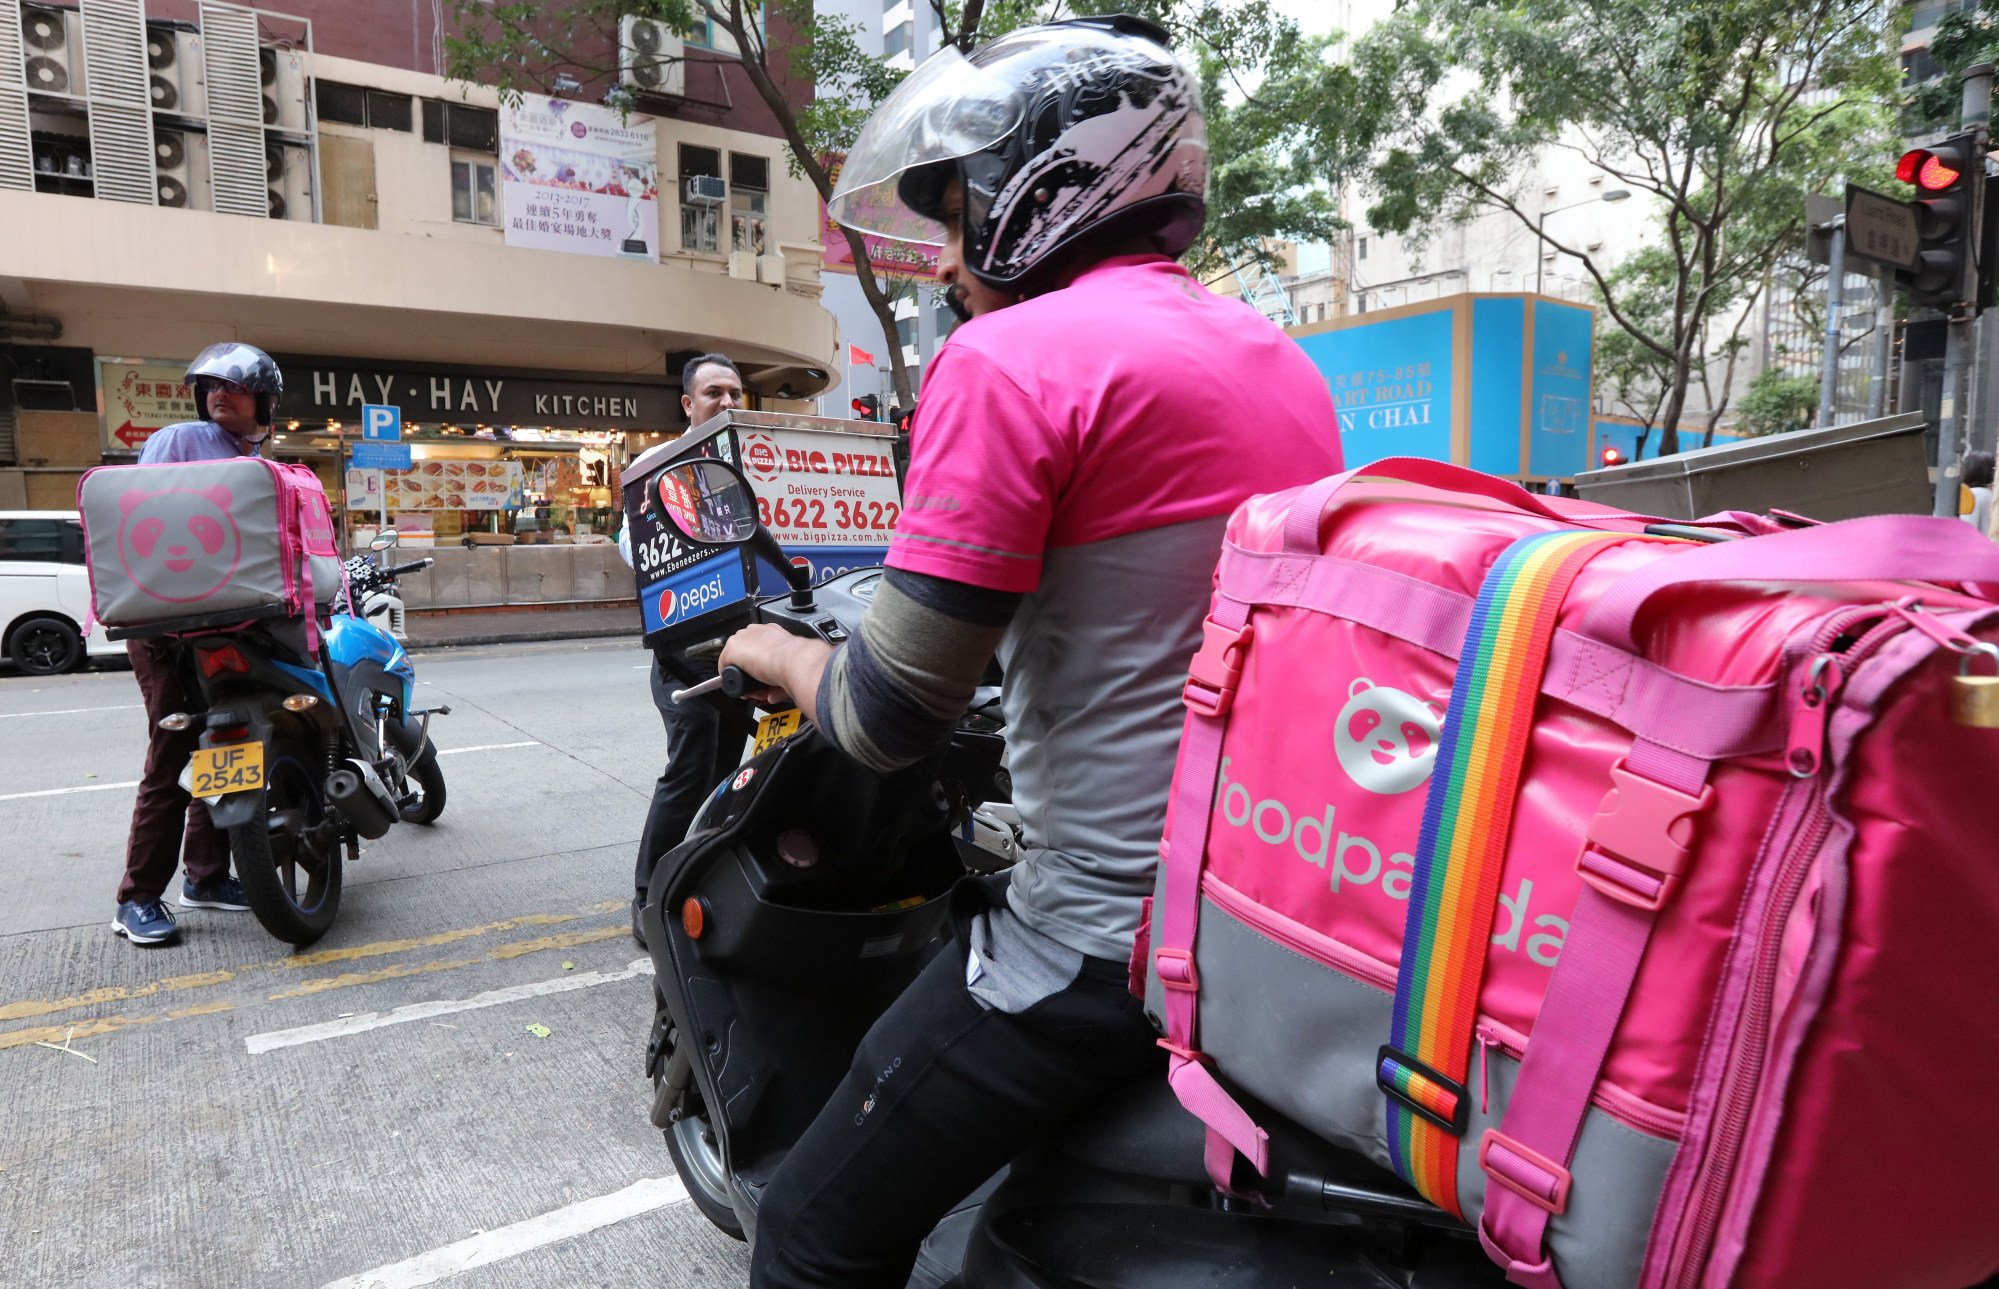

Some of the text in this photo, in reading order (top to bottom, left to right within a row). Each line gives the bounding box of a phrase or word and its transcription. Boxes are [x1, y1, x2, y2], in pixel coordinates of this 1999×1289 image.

[535, 190, 590, 209] 2013-2017
[526, 203, 598, 224] 連續5年勇奪
[512, 217, 612, 240] 最佳婚宴場地大獎
[313, 371, 638, 418] HAY HAY KITCHEN
[1375, 380, 1432, 402] ROAD
[369, 408, 394, 437] P
[1368, 404, 1431, 429] CHAI
[752, 457, 774, 466] PIZZA
[754, 448, 769, 457] BIG
[786, 449, 894, 478] BIG PIZZA
[787, 484, 866, 498] Delivery Service
[755, 497, 828, 529] 3622
[834, 500, 900, 530] 3622
[772, 532, 888, 543] www.bigpizza.com.hk
[680, 573, 725, 616] pepsi
[767, 714, 790, 737] RF
[212, 748, 245, 770] UF
[196, 765, 261, 793] 2543
[1213, 756, 1571, 967] foodpada
